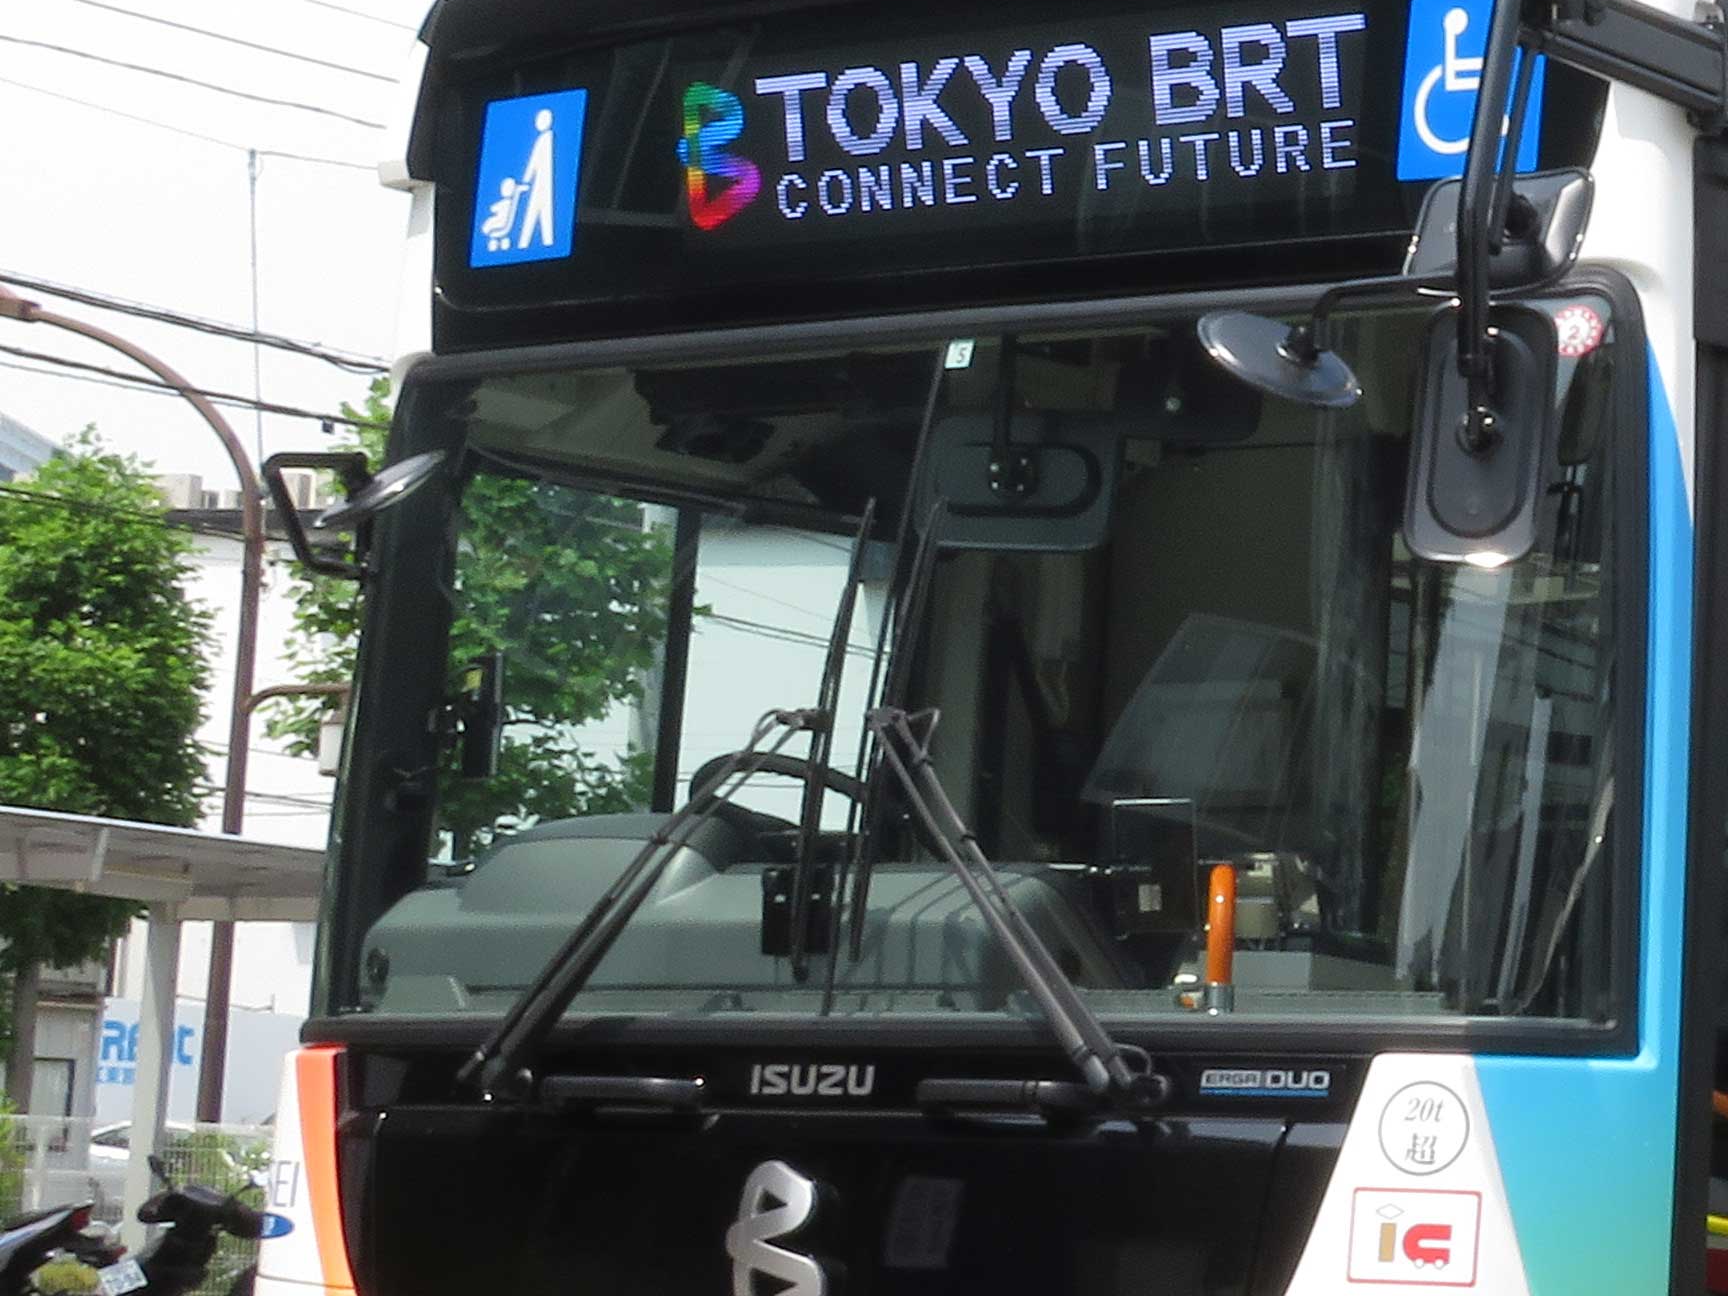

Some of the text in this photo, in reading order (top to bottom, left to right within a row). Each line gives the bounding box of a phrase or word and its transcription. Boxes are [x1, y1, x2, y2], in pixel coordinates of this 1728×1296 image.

[755, 42, 1114, 162] TOKYO
[1149, 12, 1368, 126] BRT
[776, 118, 1358, 220] CONNECT FUTURE
[750, 1063, 876, 1096] ISUZU
[1264, 1070, 1331, 1090] DUO
[1403, 1097, 1445, 1123] 20t
